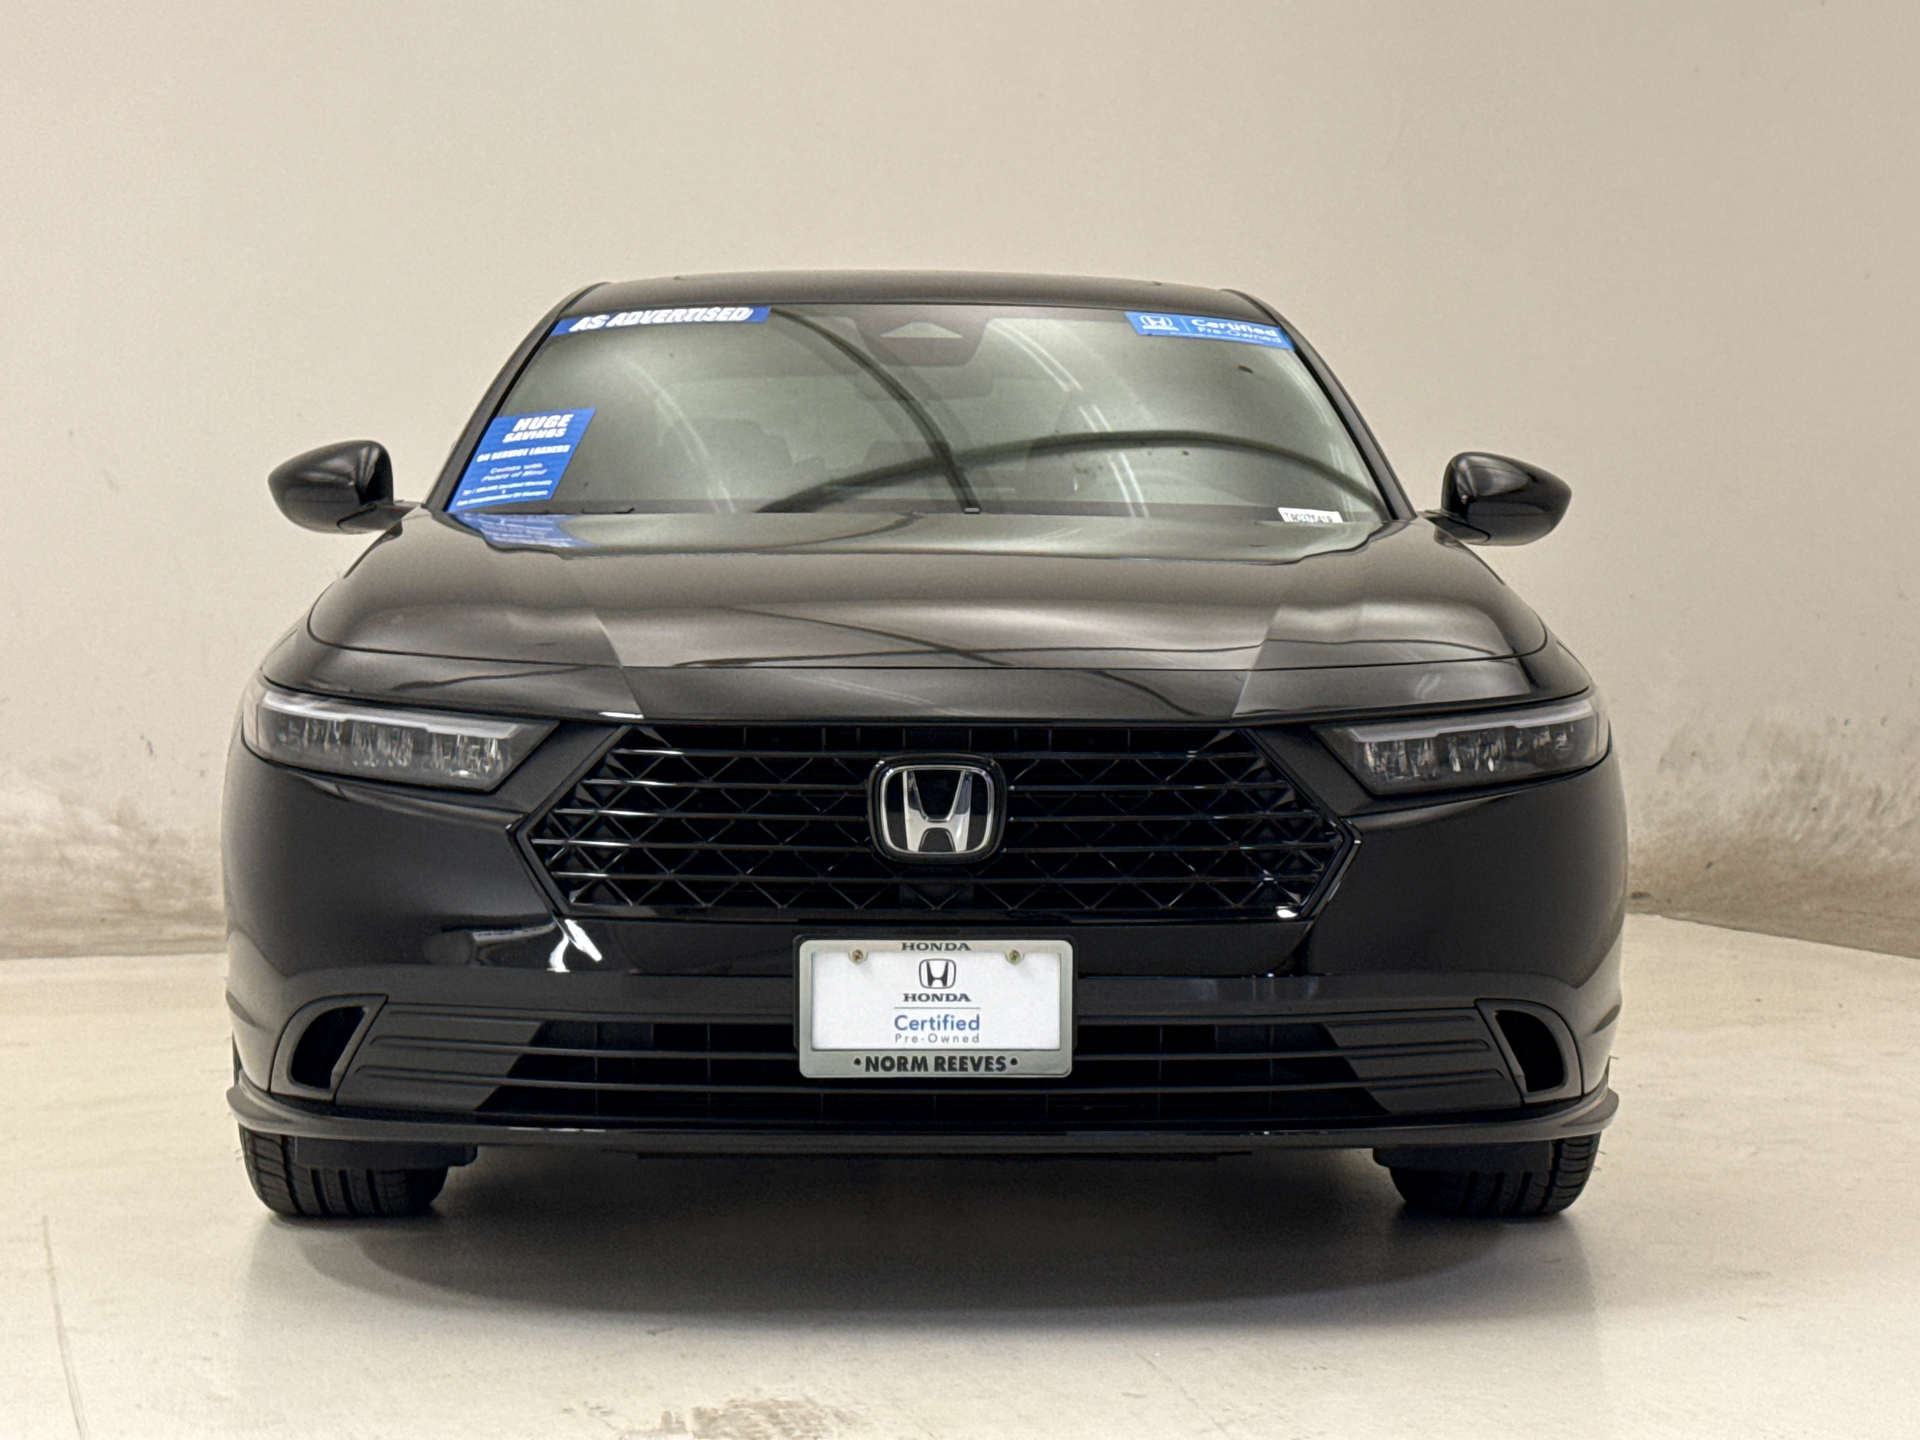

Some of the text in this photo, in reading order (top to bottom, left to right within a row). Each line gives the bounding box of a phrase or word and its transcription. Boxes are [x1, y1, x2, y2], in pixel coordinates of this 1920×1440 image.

[569, 307, 754, 332] AS ADVERTISED
[1191, 318, 1278, 337] Certified
[1197, 327, 1282, 344] Pre-Owned
[513, 414, 574, 432] HUGE
[502, 427, 567, 443] SAVINGS
[901, 942, 972, 951] HONDA
[903, 993, 972, 1003] HONDA
[894, 1014, 981, 1032] Certified
[895, 1033, 980, 1044] Pre-Owned
[865, 1056, 1007, 1073] NORM REEVES
